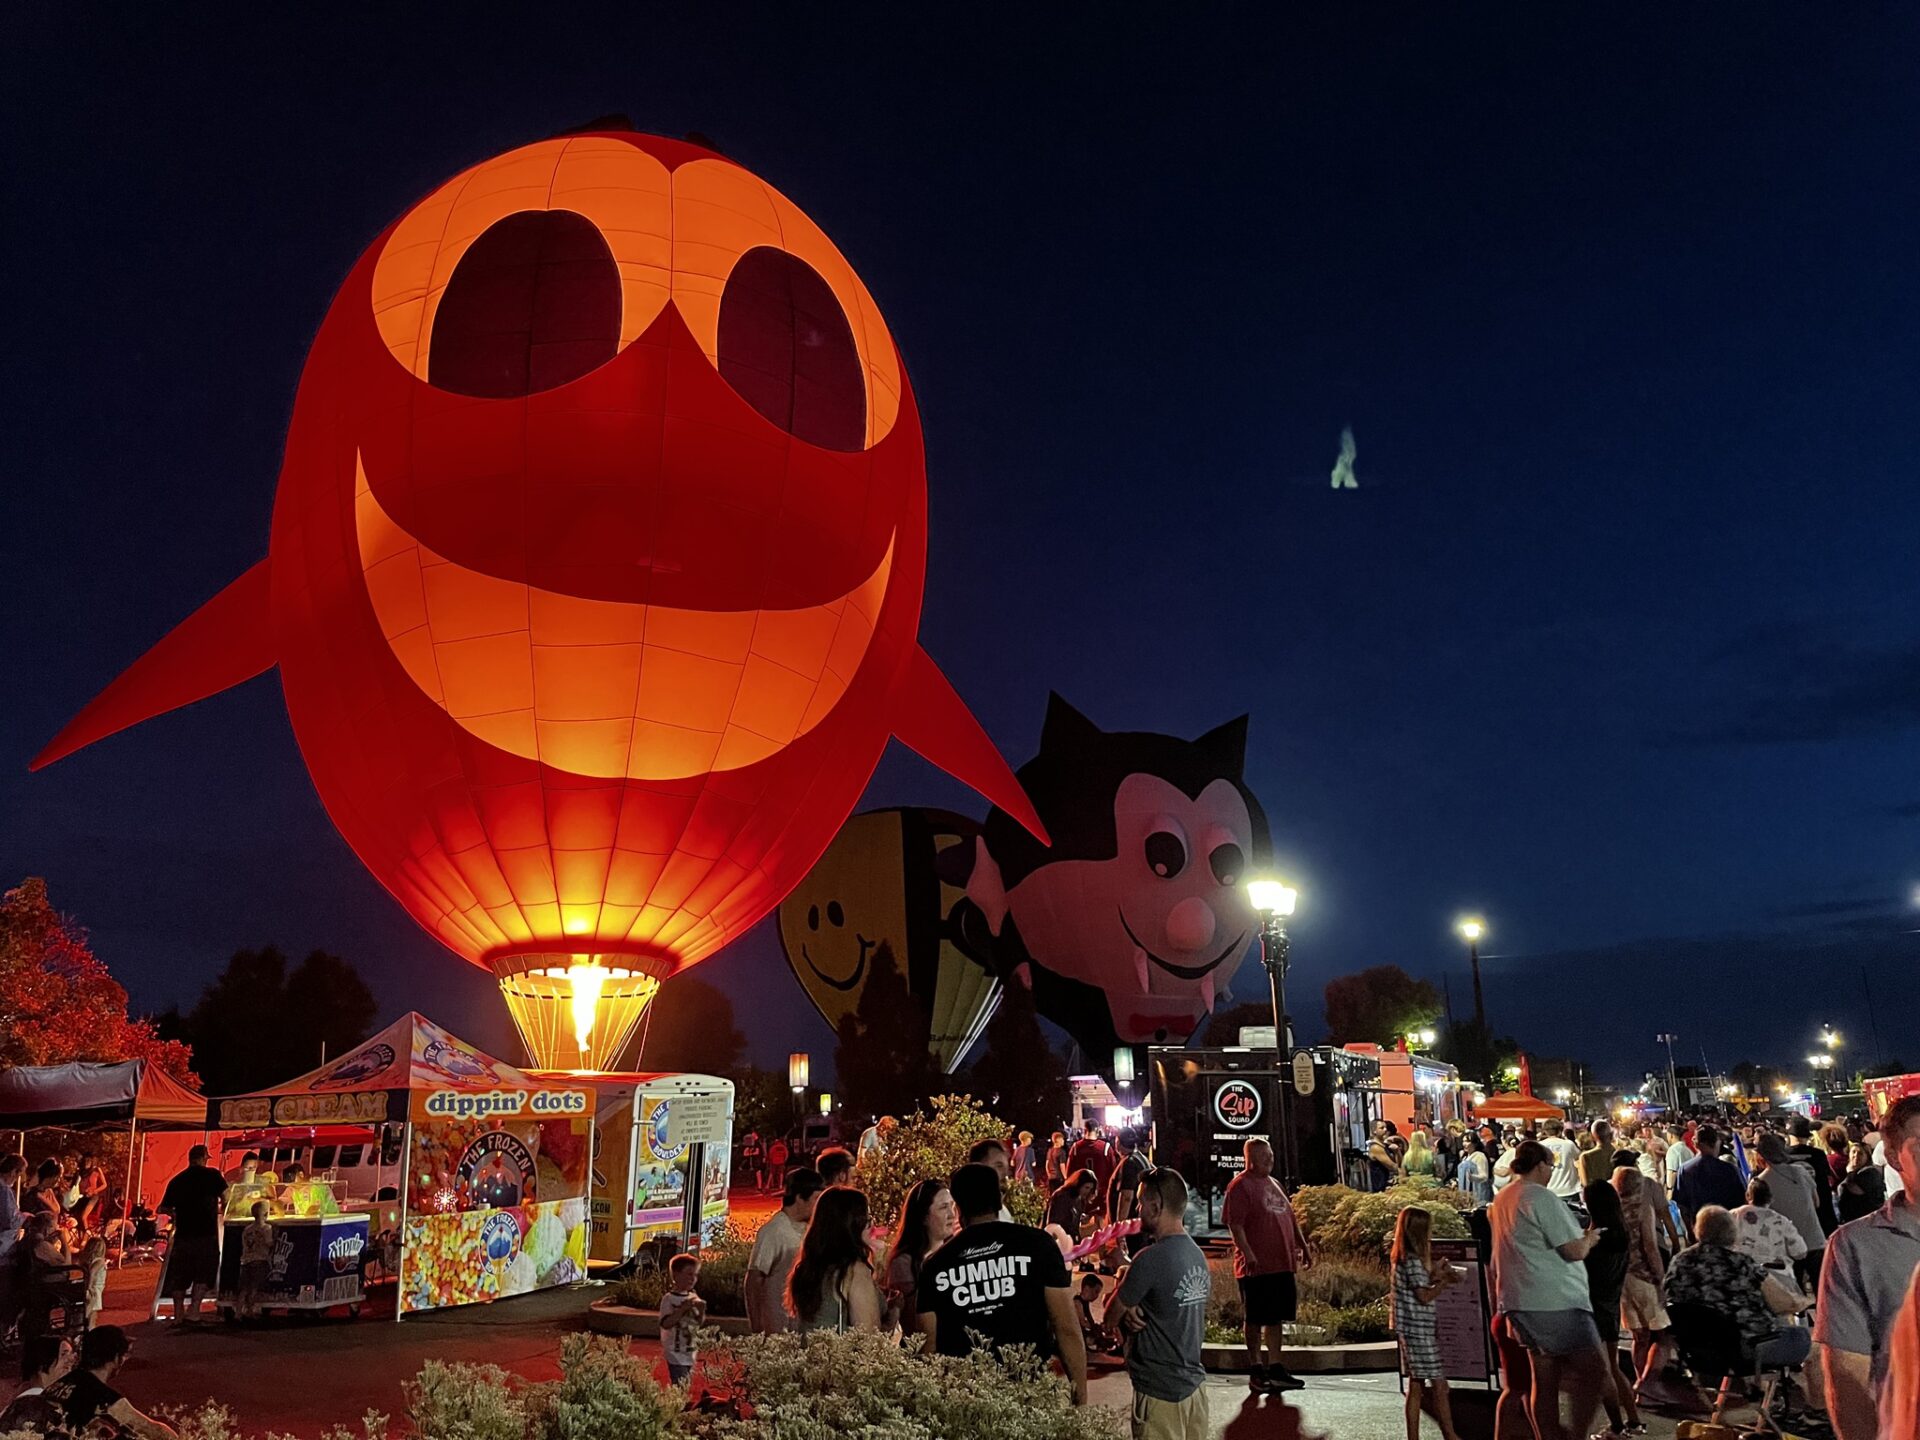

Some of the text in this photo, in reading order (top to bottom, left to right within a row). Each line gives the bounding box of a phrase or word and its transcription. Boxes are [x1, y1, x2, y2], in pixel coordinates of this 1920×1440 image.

[220, 1092, 389, 1127] ICE CREAM
[427, 1091, 584, 1118] dippin' dots
[652, 1103, 666, 1120] THE
[462, 1134, 532, 1170] THE FROZEN
[591, 1202, 611, 1213] .COM
[484, 1212, 518, 1236] THE FROZEN
[935, 1255, 1032, 1291] SUMMIT
[952, 1276, 1016, 1306] CLUB
